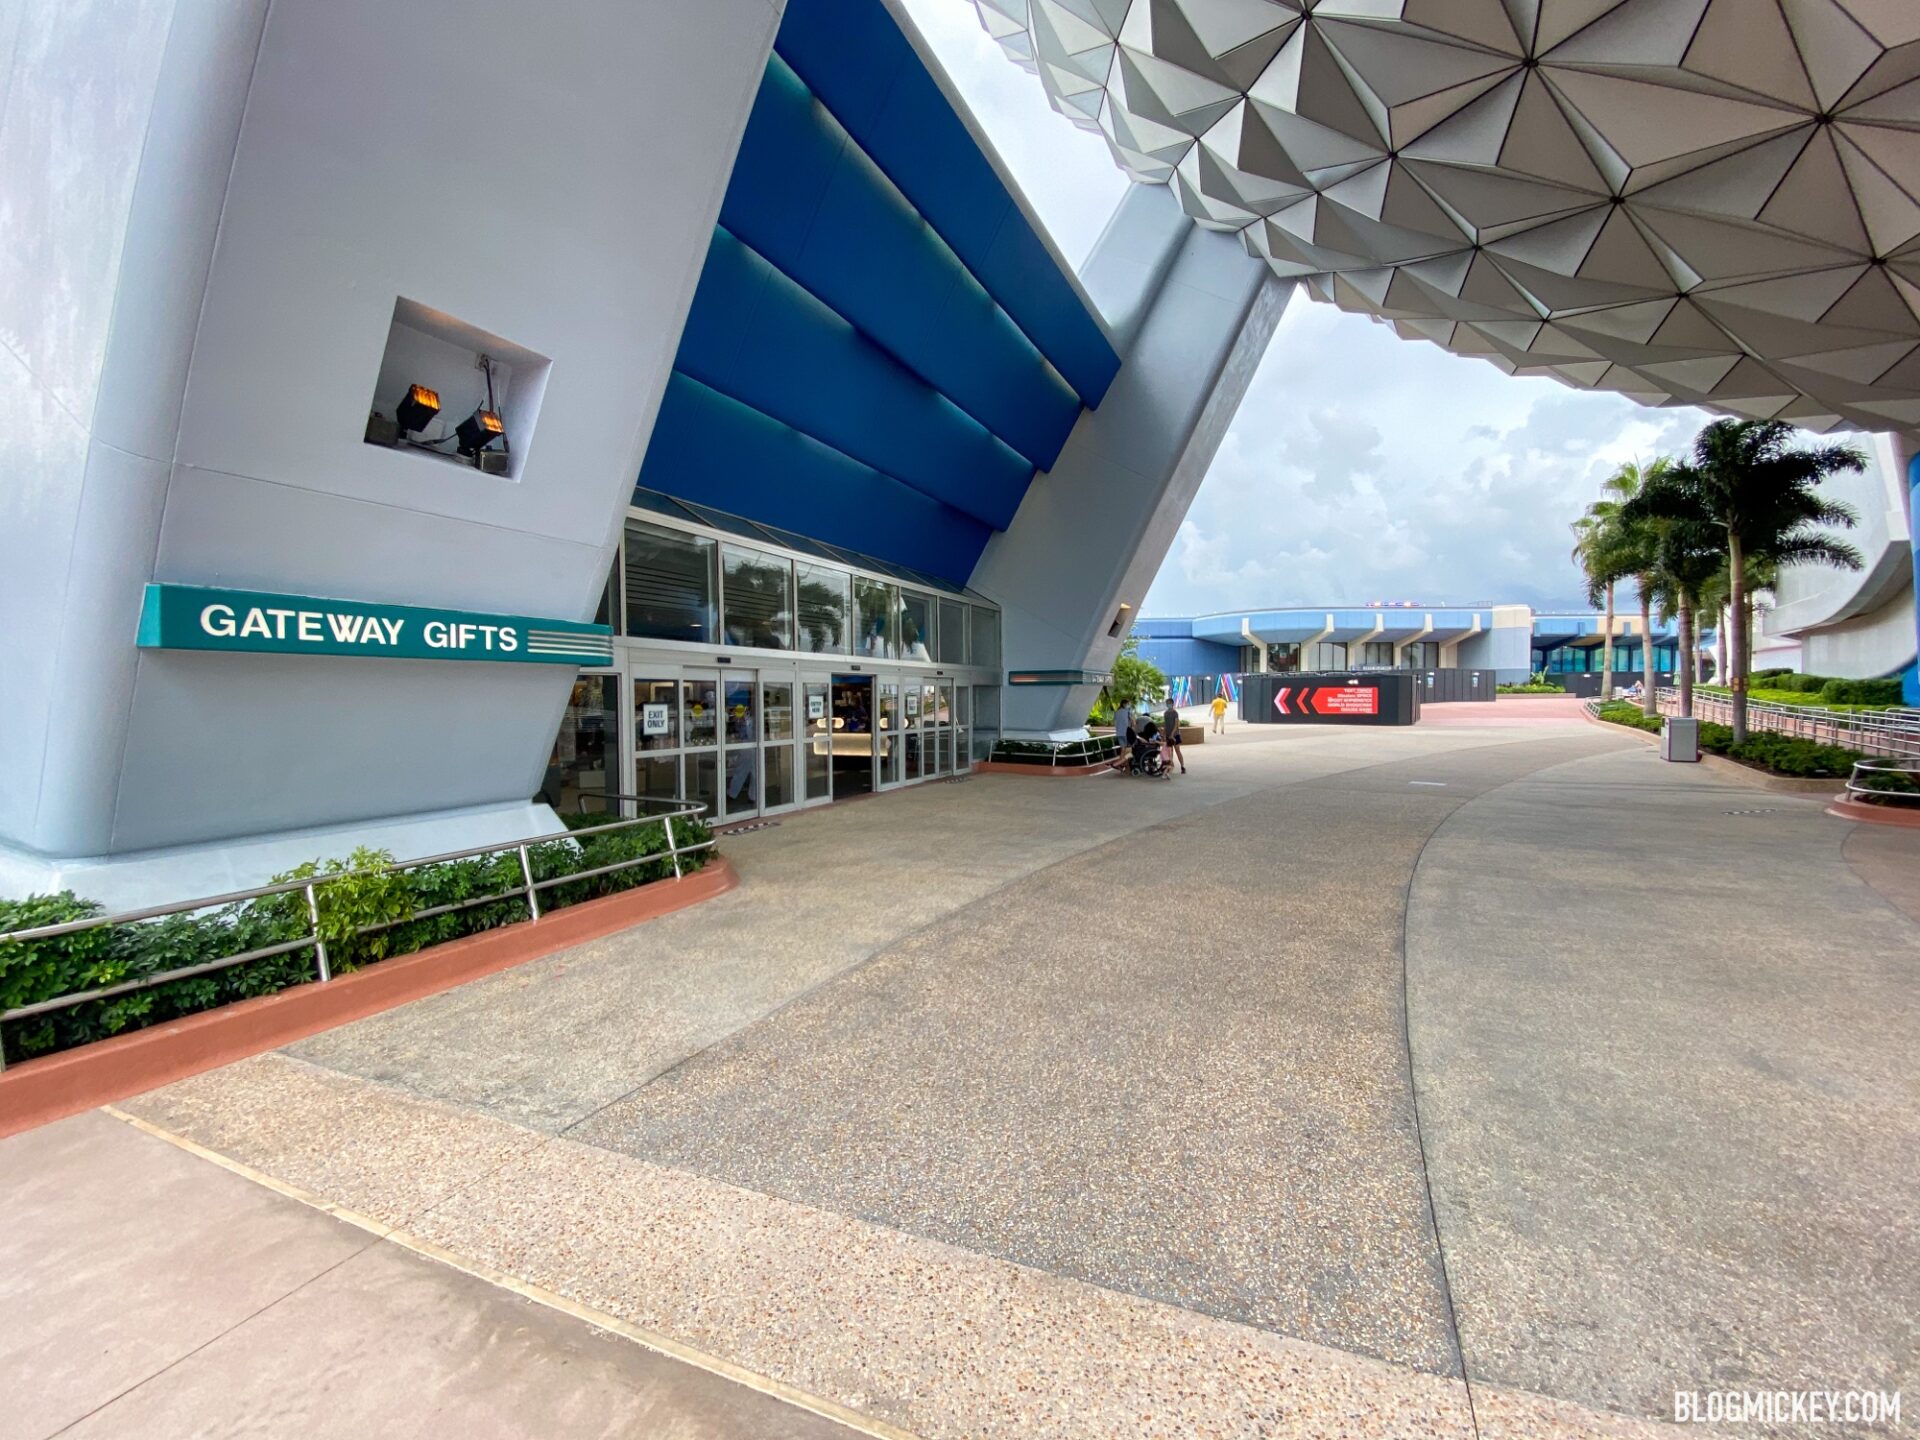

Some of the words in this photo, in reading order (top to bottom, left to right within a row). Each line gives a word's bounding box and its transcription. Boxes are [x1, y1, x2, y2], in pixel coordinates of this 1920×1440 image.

[200, 604, 405, 645] GATEWAY
[423, 621, 518, 652] GIFTS
[648, 711, 664, 719] EXIT
[647, 720, 665, 728] ONLY
